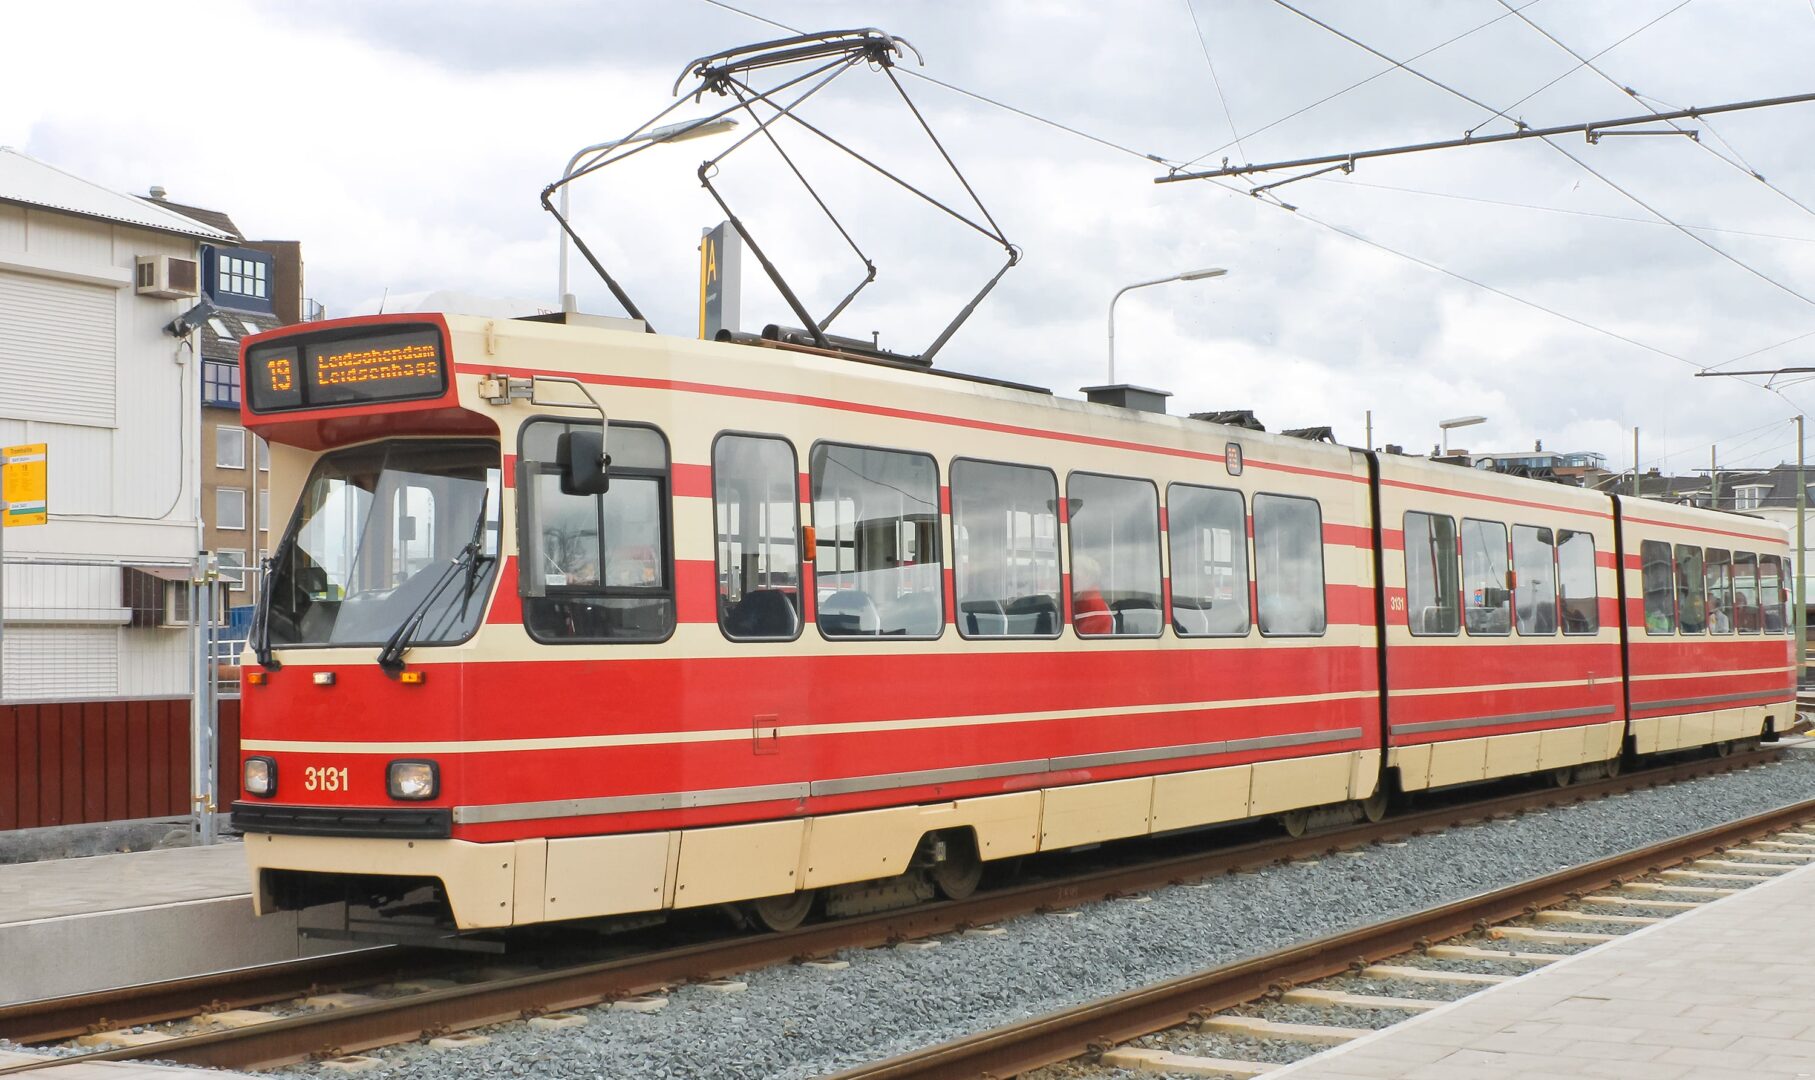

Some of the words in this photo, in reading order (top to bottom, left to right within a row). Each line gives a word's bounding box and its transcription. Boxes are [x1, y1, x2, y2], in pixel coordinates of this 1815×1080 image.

[707, 239, 717, 286] A
[267, 359, 291, 391] 19
[1390, 596, 1404, 611] 3131
[305, 766, 348, 791] 3131
